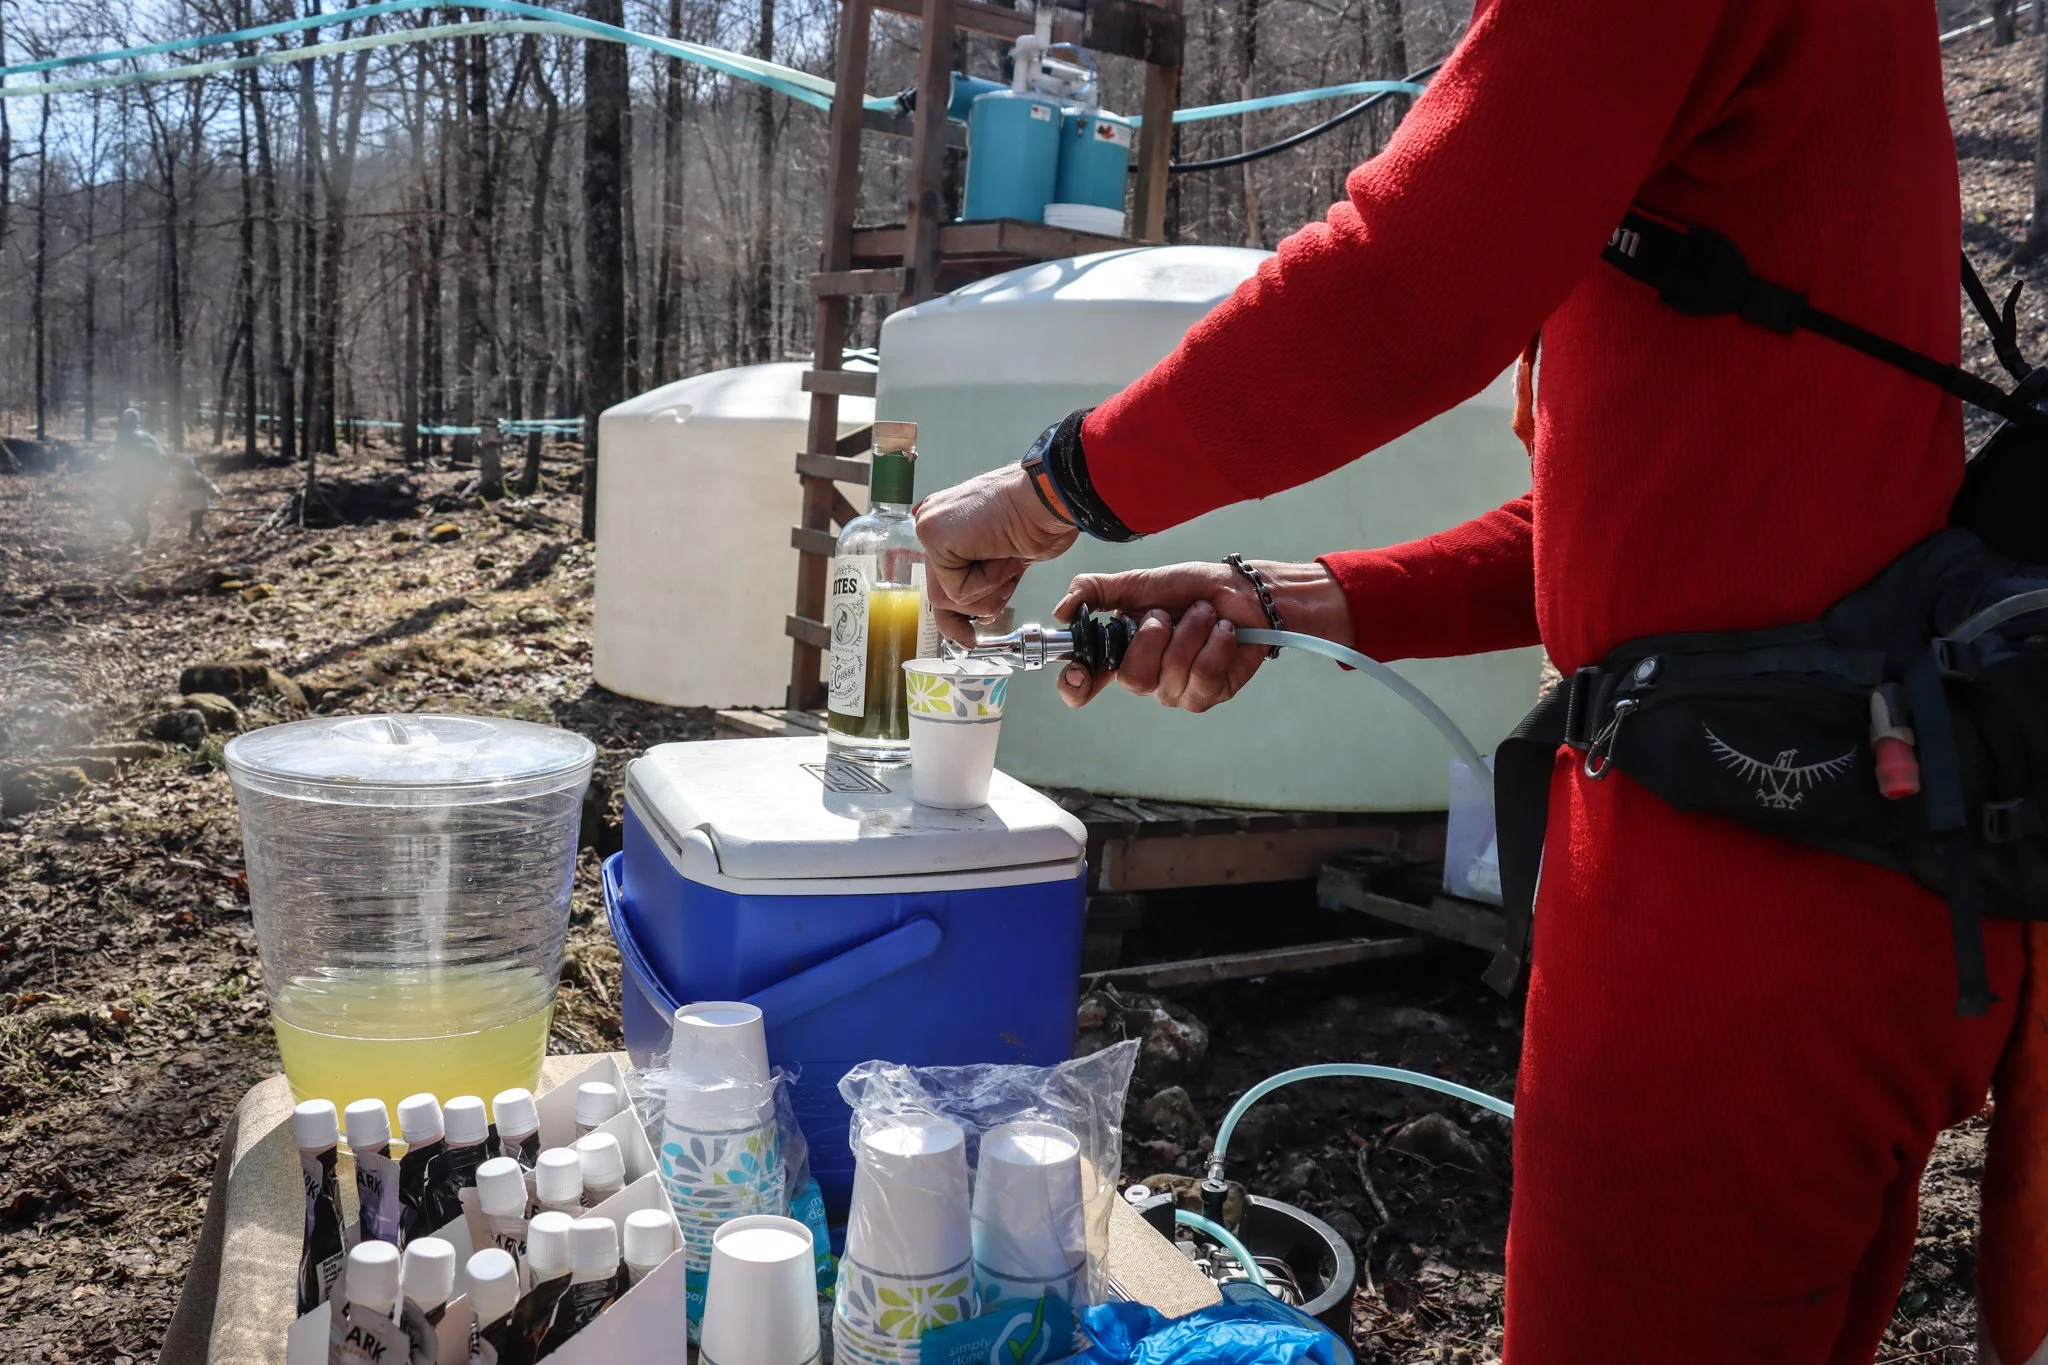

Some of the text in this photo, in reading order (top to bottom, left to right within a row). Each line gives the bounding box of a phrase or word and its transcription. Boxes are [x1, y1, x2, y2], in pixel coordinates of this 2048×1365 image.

[345, 1325, 387, 1363] ARK
[948, 1337, 992, 1357] simply
[952, 1350, 985, 1365] done
